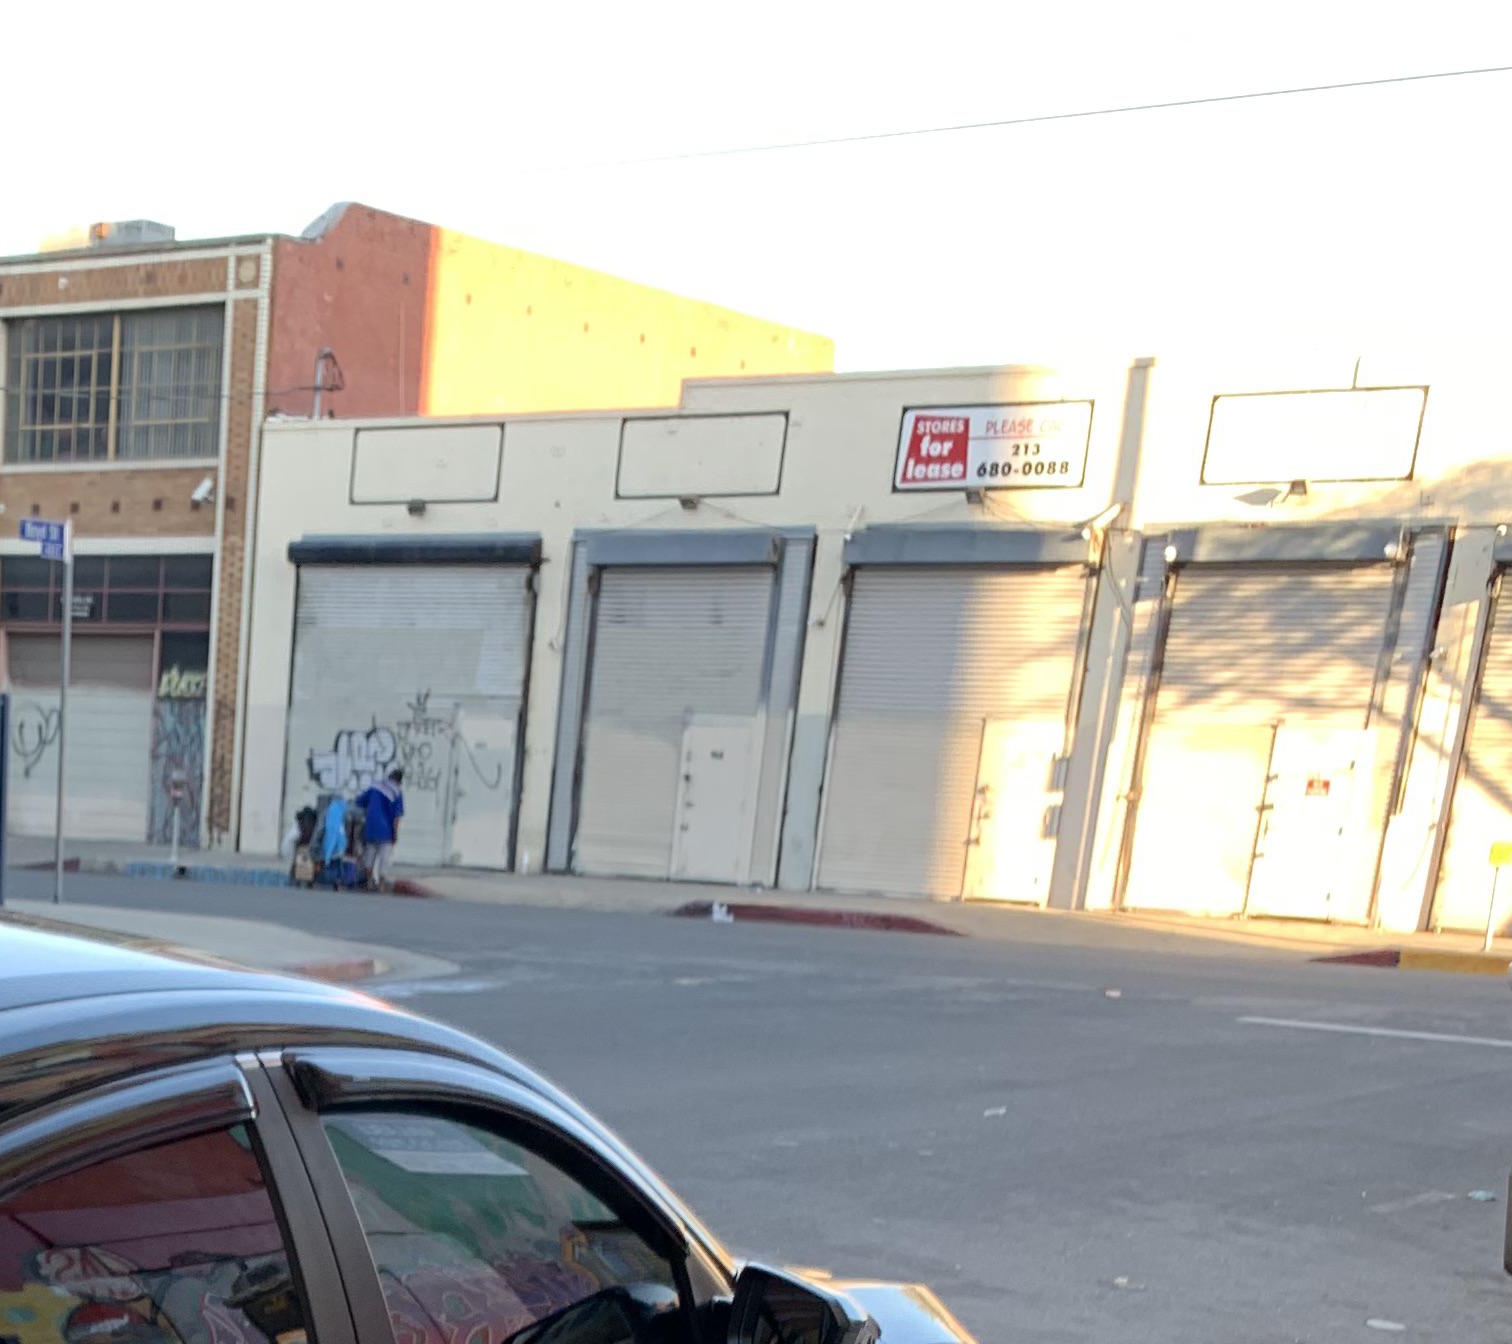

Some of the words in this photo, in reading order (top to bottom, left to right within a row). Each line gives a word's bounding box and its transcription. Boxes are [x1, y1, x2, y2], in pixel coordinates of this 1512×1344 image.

[916, 418, 965, 435] STORES
[985, 418, 1033, 435] PLEASE
[920, 436, 954, 458] for
[1011, 442, 1041, 457] 213
[905, 458, 964, 480] lease
